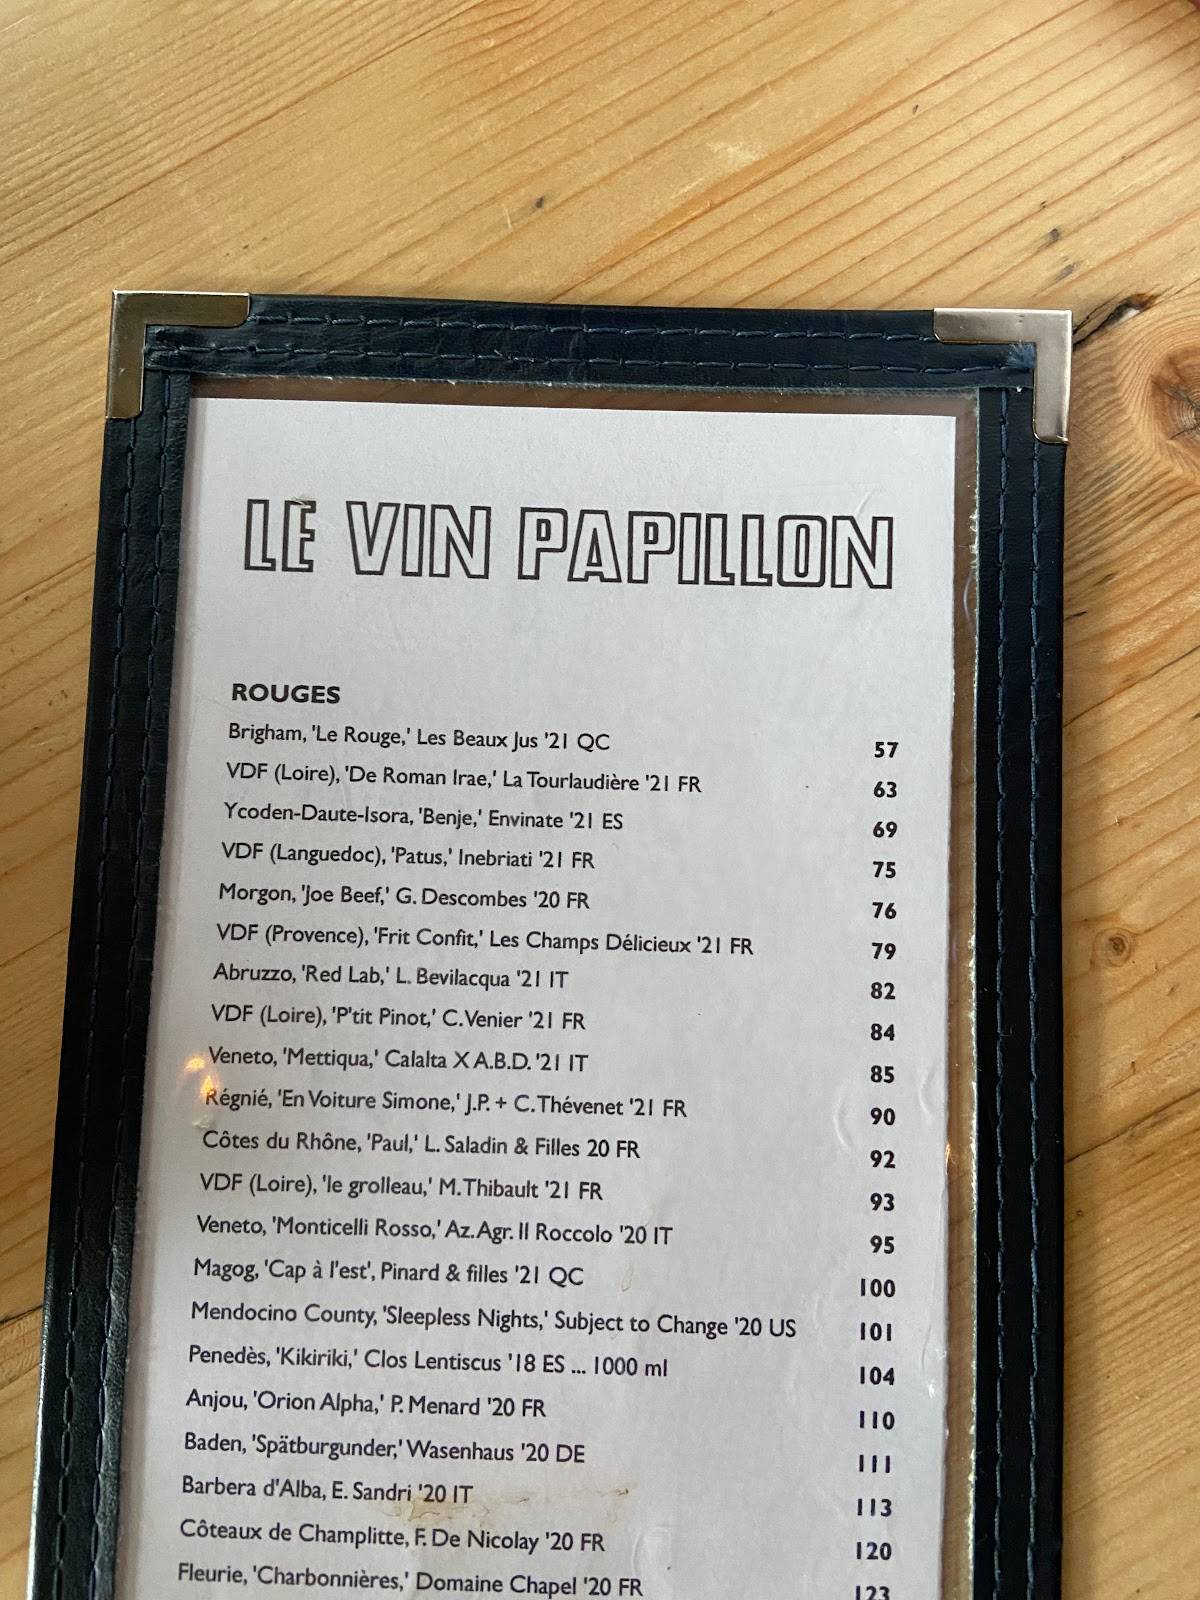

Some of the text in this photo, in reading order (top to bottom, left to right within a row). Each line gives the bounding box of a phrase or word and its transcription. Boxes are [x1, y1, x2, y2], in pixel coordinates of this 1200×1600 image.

[243, 498, 894, 590] LE VIN PAPILLON
[231, 682, 341, 705] ROUGES
[228, 722, 611, 753] Brigham, 'Le Rouge,' Les Beaux Jus '21 QC
[873, 741, 900, 759] 57
[225, 761, 669, 792] VDF (Loire), 'De Roman Irae,' La Tourlaudière '21
[872, 780, 898, 799] 63
[223, 801, 624, 831] Ycoden-Daute-Isora, 'Benje,' Envinate ES
[872, 820, 898, 839] 69
[221, 841, 596, 870] VDF (Languedoc), 'Patus,' Inebriati '21 FR
[872, 860, 897, 879] 75
[218, 882, 561, 909] Morgon, 'Joe Beef,' Descombes '20
[871, 901, 898, 920] 76
[215, 922, 754, 956] VDF (Provence), 'Frit Confit,' Les Champs Délicieux FR
[871, 941, 897, 961] 79
[212, 962, 570, 992] Abruzzo, 'Red Lab,' Bevilacqua '21 IT
[870, 981, 896, 1001] 82
[210, 1003, 553, 1030] VDF (Loire), 'P'tit Pinot,' '21
[870, 1022, 896, 1042] 84
[208, 1045, 590, 1073] Veneto, 'Mettiqua,' Calalta IT
[870, 1064, 896, 1085] 85
[277, 1088, 305, 1108] 'En
[307, 1089, 377, 1110] Voiture
[381, 1090, 461, 1113] Simone,'
[629, 1097, 654, 1117] '21
[662, 1098, 688, 1118] FR
[869, 1106, 897, 1127] 90
[202, 1129, 611, 1158] Côtes du Rhône, 'Paul,' Saladin Filles 20
[869, 1149, 897, 1169] 92
[199, 1172, 604, 1201] VDF (Loire), 'le grolleau,' '21 FR
[869, 1191, 896, 1212] 93
[196, 1214, 674, 1246] Veneto, 'Monticelli Rosso,' Roccolo IT
[869, 1234, 895, 1255] 95
[193, 1256, 260, 1284] Magog,
[264, 1258, 307, 1284] 'Cap
[380, 1261, 440, 1282] Pinard
[465, 1263, 509, 1284] filles
[514, 1264, 539, 1285] '21
[860, 1277, 897, 1298] 100
[191, 1300, 797, 1341] Mendocino County, 'Sleepless Nights,' Subject to Change '20 US
[860, 1321, 892, 1342] 101
[188, 1343, 668, 1378] Penedès, 'Kikiriki,' Clos Lentiscus ES 1000 ml
[859, 1365, 895, 1387] 104
[185, 1387, 516, 1418] Anjou, 'Orion Alpha,' Menard '20
[859, 1409, 896, 1431] 110
[184, 1431, 247, 1455] Baden,
[405, 1438, 515, 1462] Wasenhaus
[520, 1442, 550, 1463] '20
[555, 1443, 586, 1464] DE
[858, 1453, 891, 1474] 111
[182, 1474, 474, 1505] Barbera d'Alba, Sandri IT
[856, 1497, 893, 1518] 113
[179, 1518, 574, 1556] Côteaux de Champlitte, De Nicolay '20
[855, 1541, 893, 1561] 120
[177, 1561, 644, 1600] Fleurie, 'Charbonnières,' Domaine Chapel FR
[855, 1584, 891, 1600] 123
